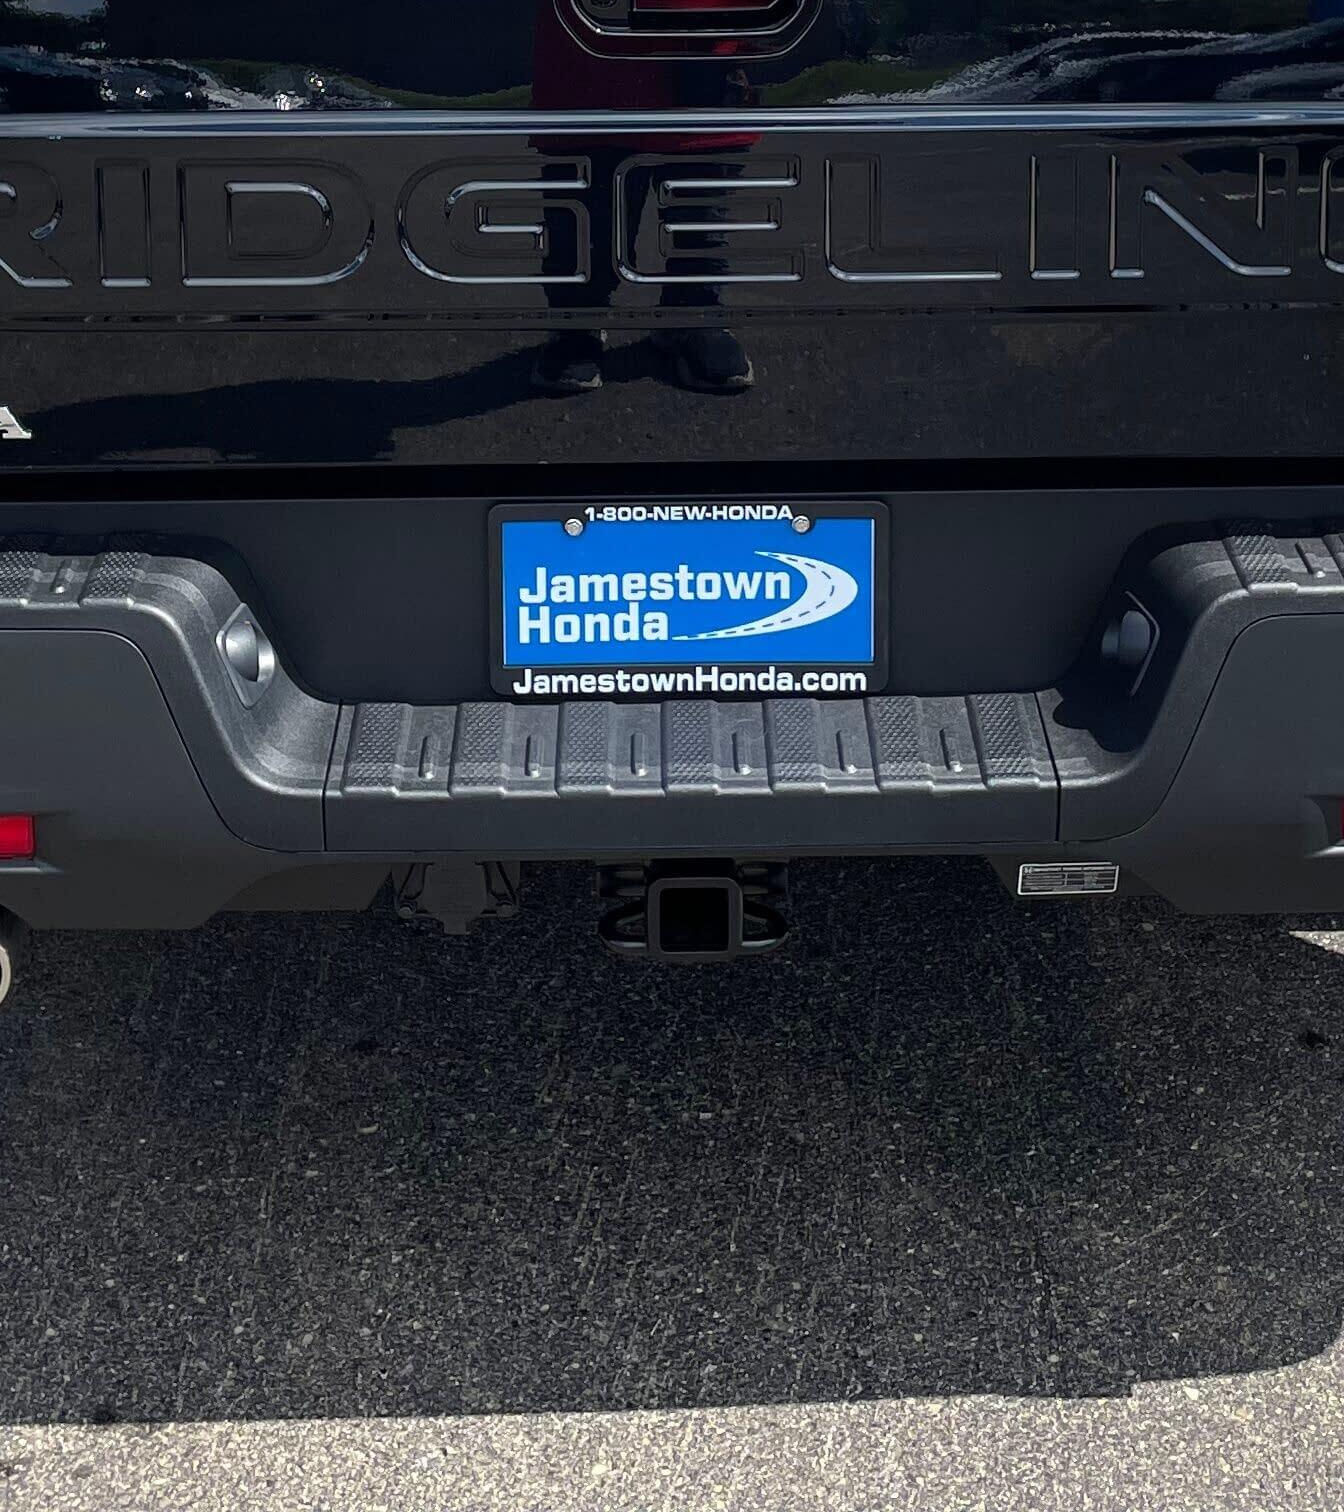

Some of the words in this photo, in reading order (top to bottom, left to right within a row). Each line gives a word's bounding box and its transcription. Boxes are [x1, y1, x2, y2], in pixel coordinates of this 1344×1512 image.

[584, 504, 794, 522] 1-800-NEW-HONDA
[518, 563, 792, 605] Jamestown
[518, 601, 670, 644] Honda
[512, 665, 868, 696] JamestownHonda.com
